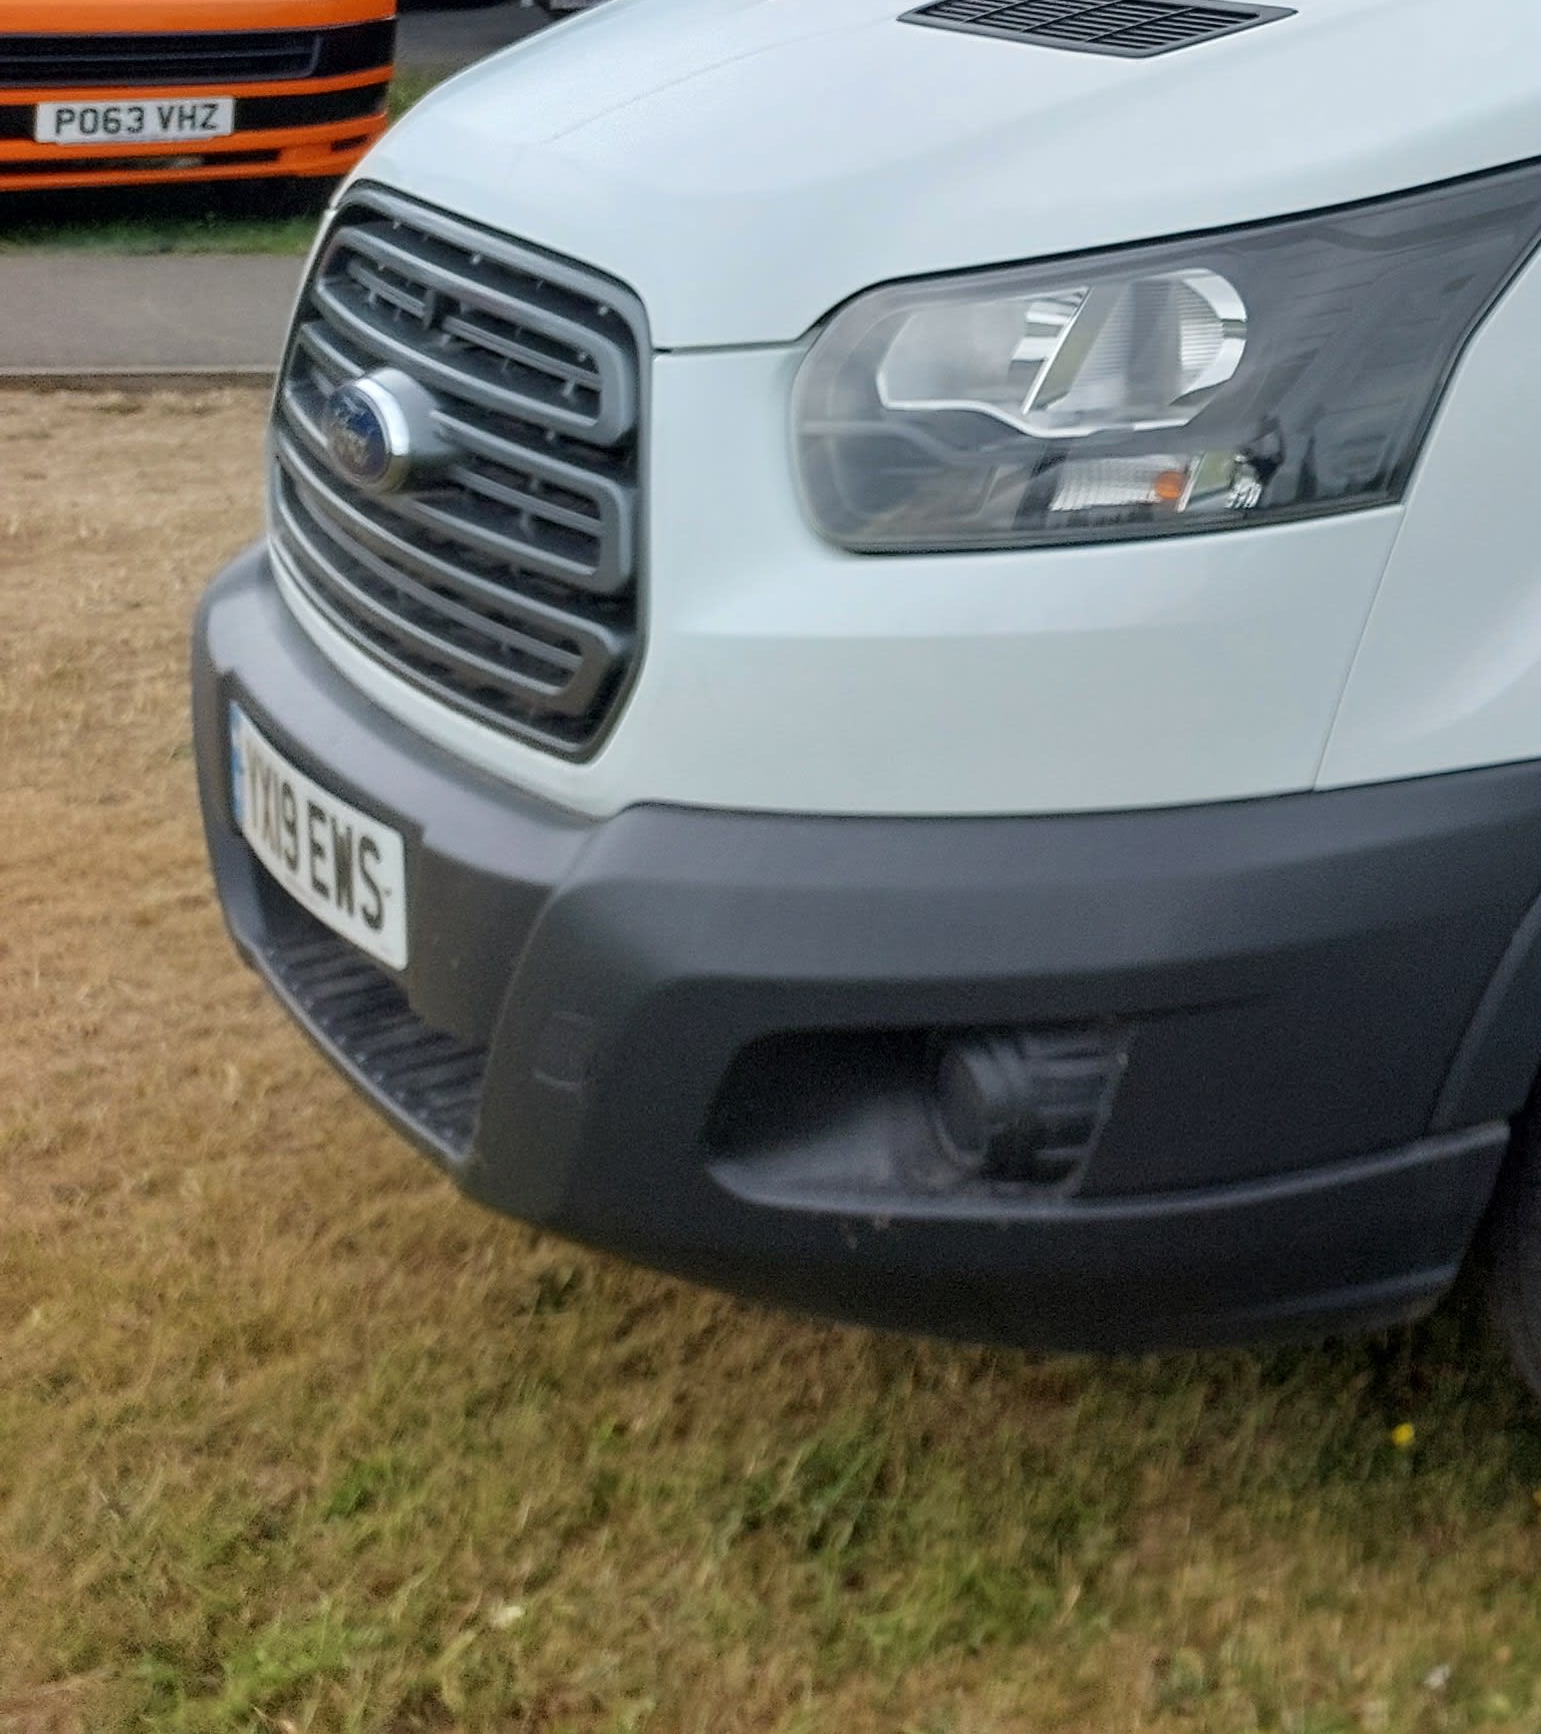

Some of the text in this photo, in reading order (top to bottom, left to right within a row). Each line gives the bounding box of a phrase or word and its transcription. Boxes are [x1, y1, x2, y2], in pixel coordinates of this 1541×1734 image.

[55, 102, 219, 135] PO63 VHZ
[307, 799, 385, 932] EWS
